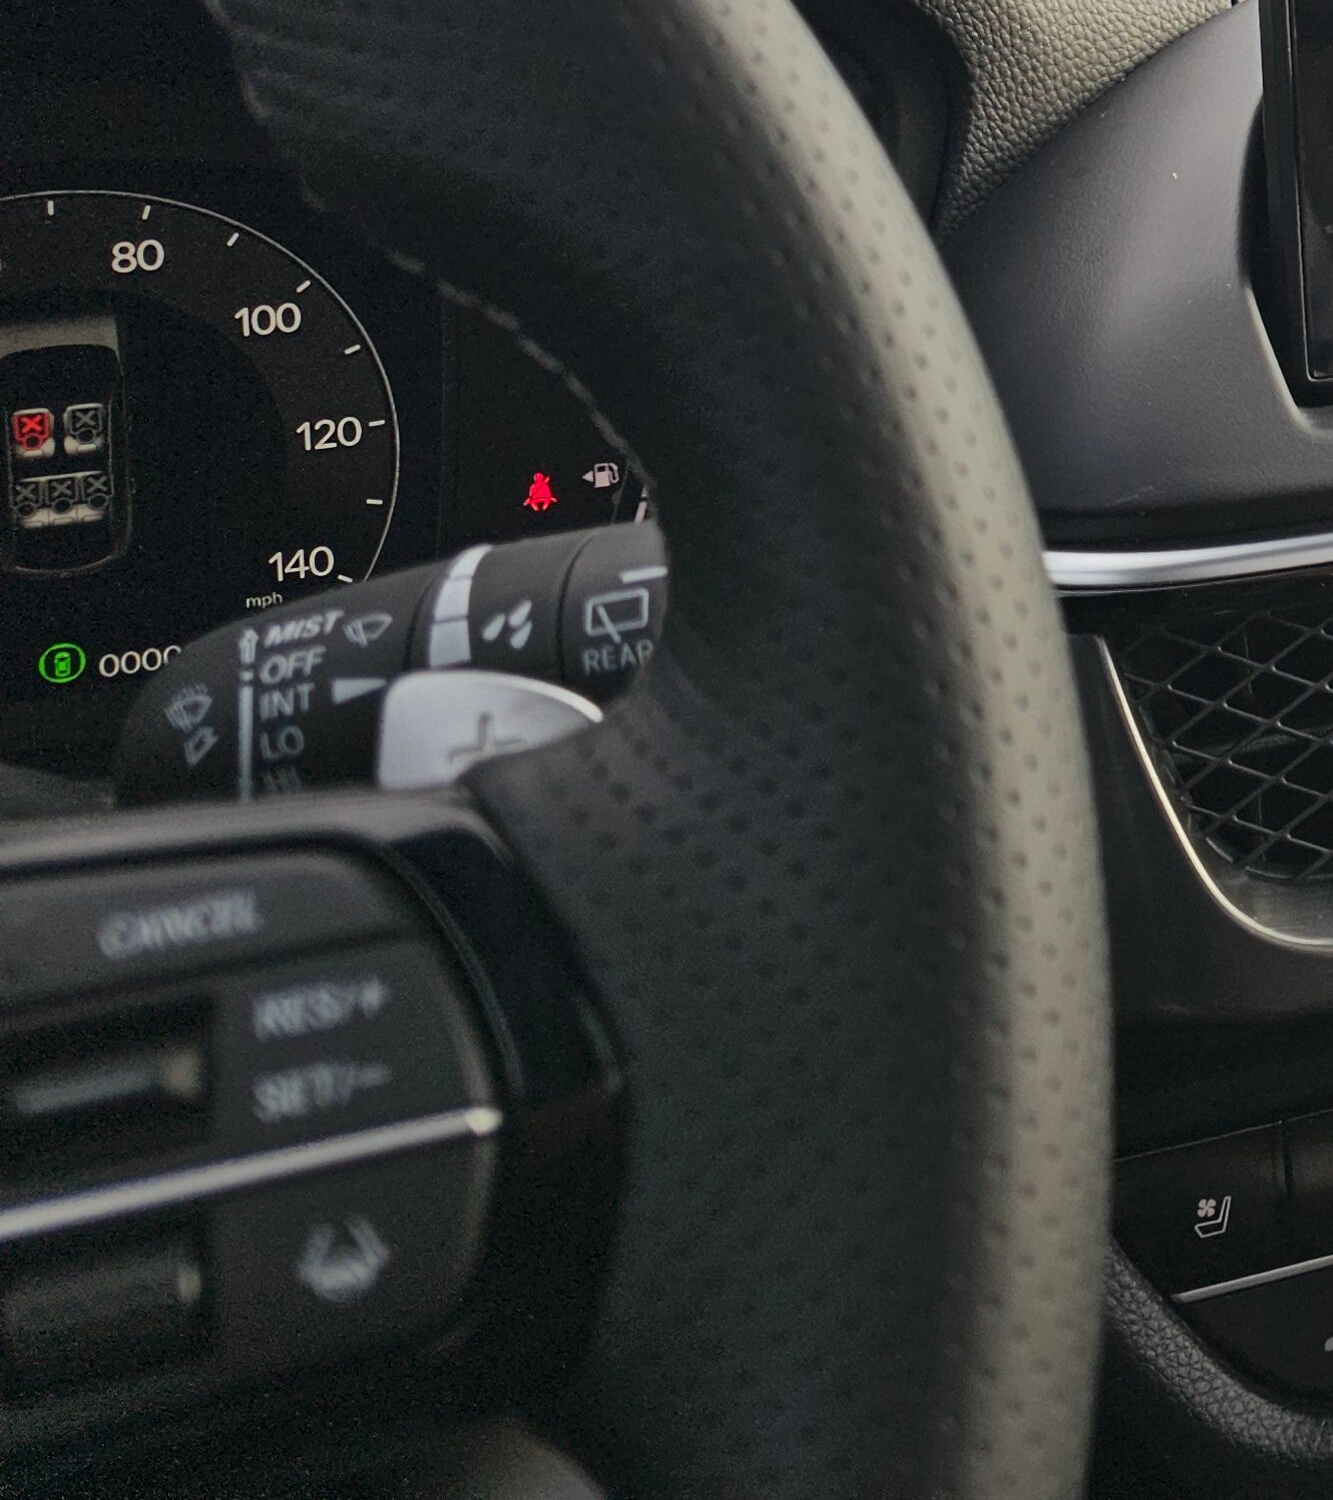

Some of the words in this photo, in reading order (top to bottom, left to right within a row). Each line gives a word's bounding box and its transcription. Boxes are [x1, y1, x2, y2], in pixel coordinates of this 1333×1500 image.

[110, 238, 165, 274] 80
[233, 302, 303, 338] 100
[295, 415, 363, 452] 120
[268, 545, 335, 583] 140
[245, 591, 283, 609] mph
[264, 609, 345, 649] MIST
[259, 645, 327, 685] OFF
[259, 682, 316, 721] INT
[260, 725, 305, 761] LO
